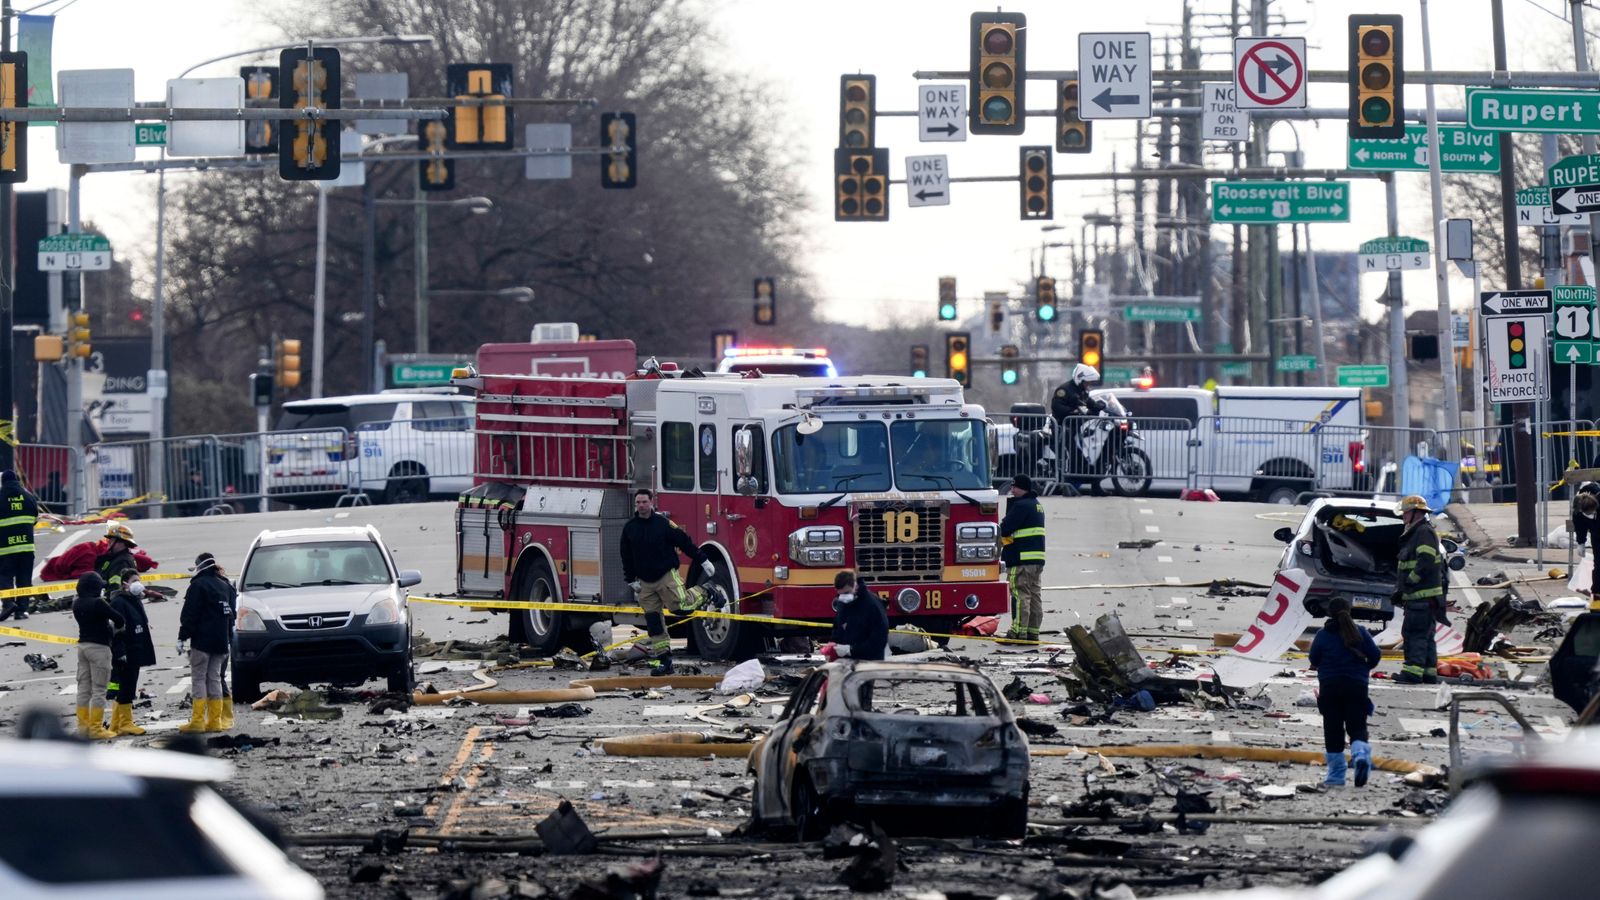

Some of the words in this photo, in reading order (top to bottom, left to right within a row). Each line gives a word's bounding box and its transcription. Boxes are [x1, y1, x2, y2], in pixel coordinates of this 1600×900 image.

[1093, 41, 1137, 59] ONE
[1092, 64, 1137, 83] WAY
[926, 90, 959, 103] ONE
[1216, 88, 1235, 101] NO
[926, 105, 960, 118] WAY
[1210, 103, 1237, 112] TUR
[1482, 98, 1582, 125] Rupert
[1218, 115, 1235, 124] ON
[1214, 127, 1238, 136] RED
[1453, 131, 1493, 146] Blvd
[1373, 152, 1407, 160] NORTH
[1443, 153, 1475, 162] SOUTH
[912, 160, 942, 172] ONE
[912, 174, 943, 186] WAY
[1218, 186, 1300, 199] Roosevelt
[1307, 186, 1343, 199] Blvd
[1515, 193, 1550, 204] ROOSE
[1578, 193, 1600, 204] ONE
[1235, 206, 1266, 214] NORTH
[1521, 210, 1530, 220] N
[39, 240, 92, 251] ROOSEVELT
[1360, 242, 1411, 253] ROOSEVELT
[46, 256, 55, 266] N
[95, 256, 102, 266] S
[1367, 257, 1375, 268] N
[1414, 256, 1422, 266] S
[1557, 289, 1590, 299] NORTH
[1502, 298, 1521, 308] ONE
[1524, 297, 1545, 307] WAY
[1567, 311, 1576, 333] 1
[104, 376, 143, 390] DING
[1501, 373, 1535, 383] PHOTO
[1322, 453, 1344, 463] 911
[883, 511, 919, 542] 18
[8, 535, 27, 545] BEALE
[925, 590, 941, 609] 18
